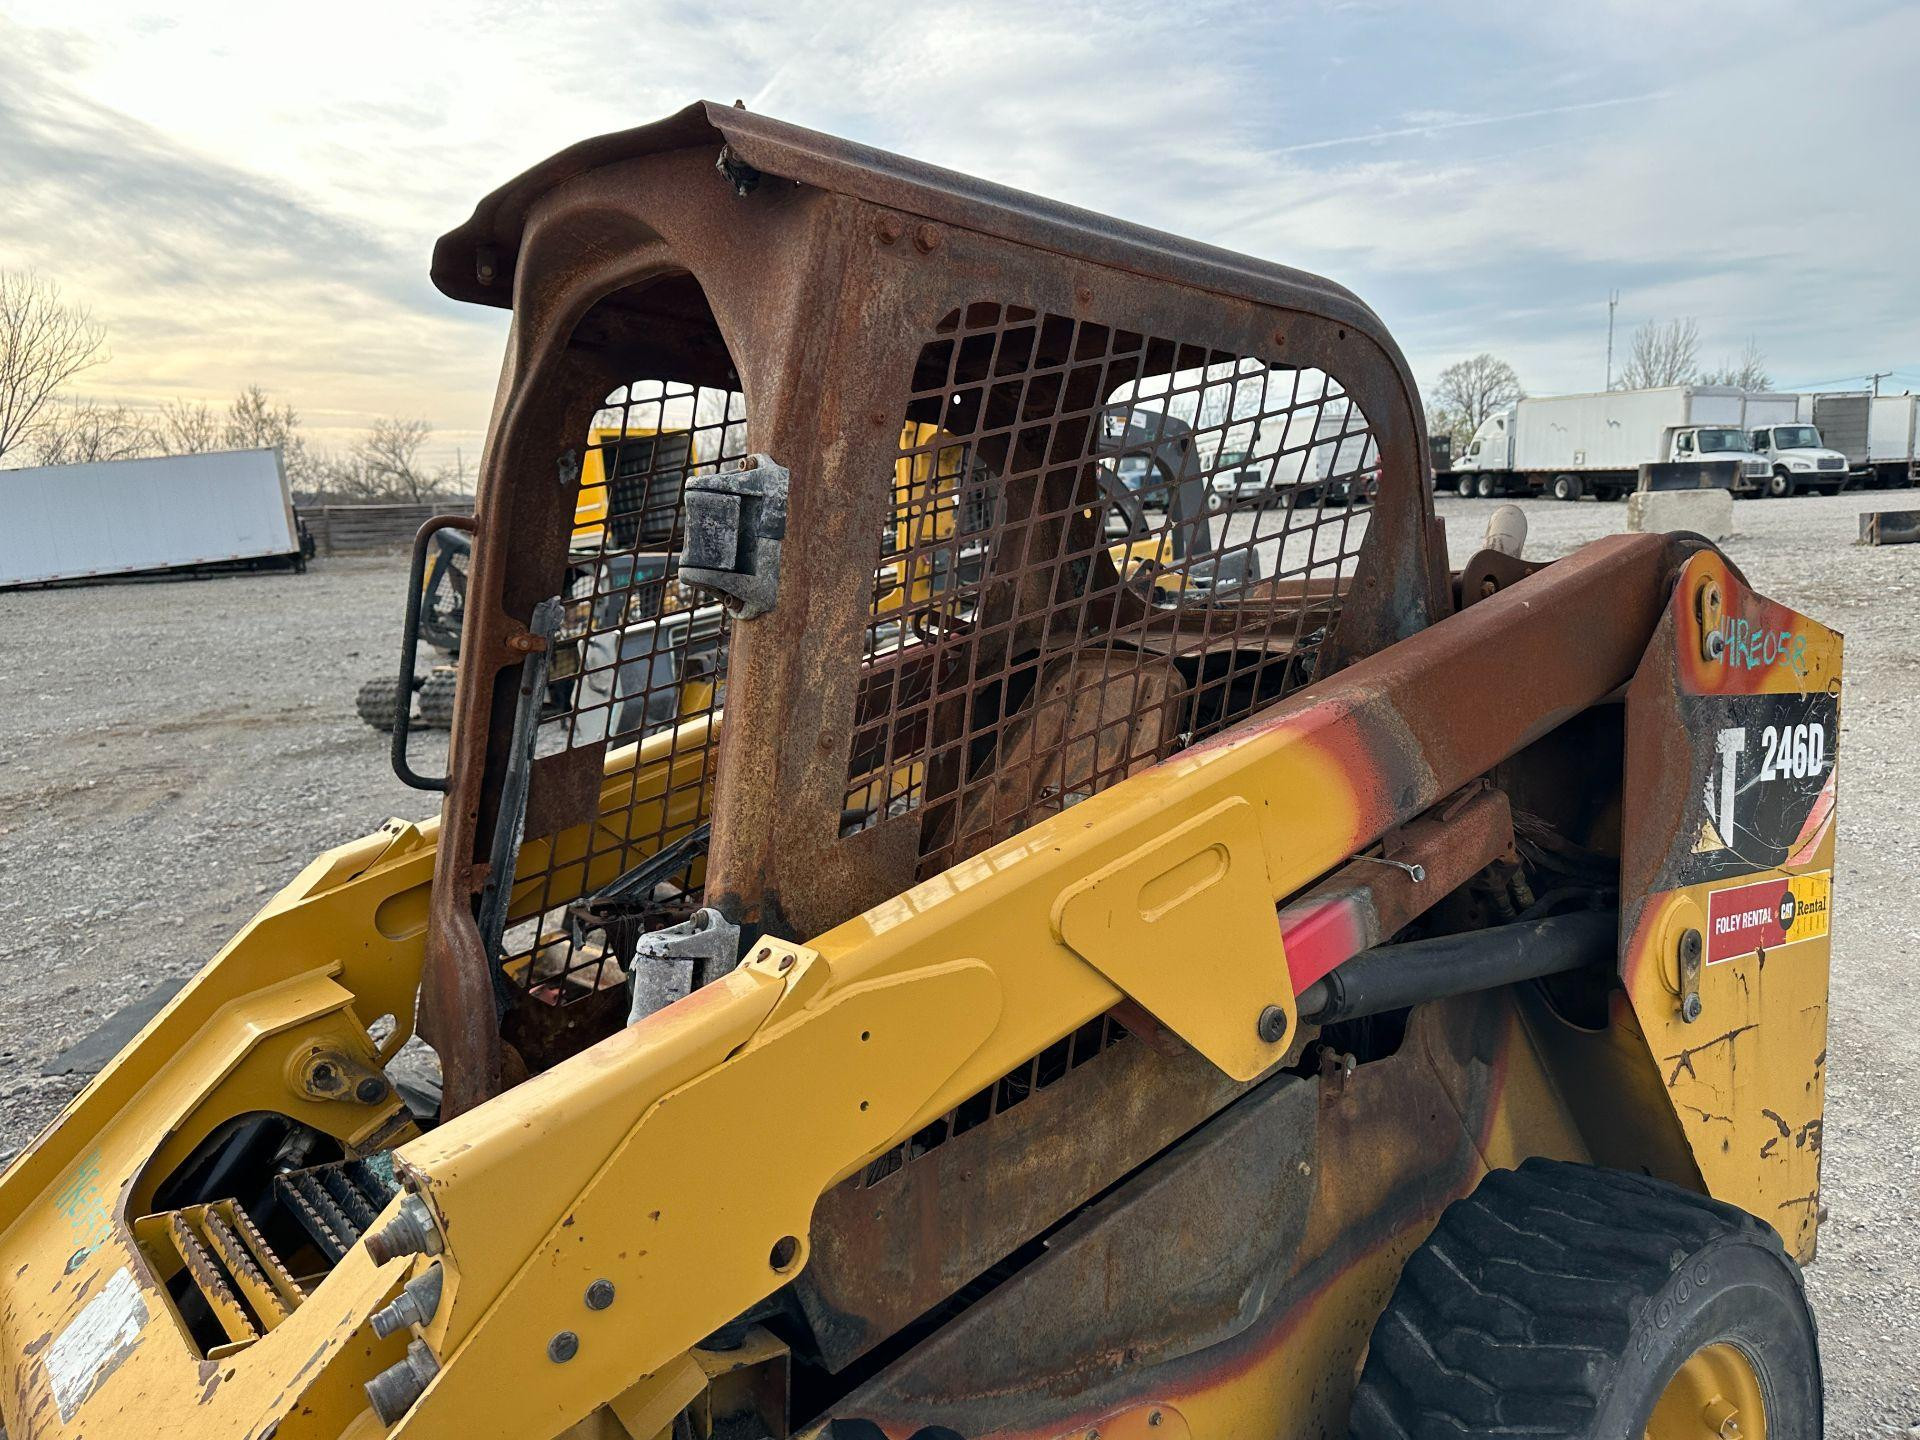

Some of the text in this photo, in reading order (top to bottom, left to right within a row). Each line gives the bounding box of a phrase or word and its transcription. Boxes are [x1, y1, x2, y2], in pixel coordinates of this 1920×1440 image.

[1760, 723, 1824, 782] 246D
[1715, 912, 1742, 936] FOLEY
[1742, 907, 1773, 929] RENTAL
[1780, 896, 1827, 921] CAT Rental
